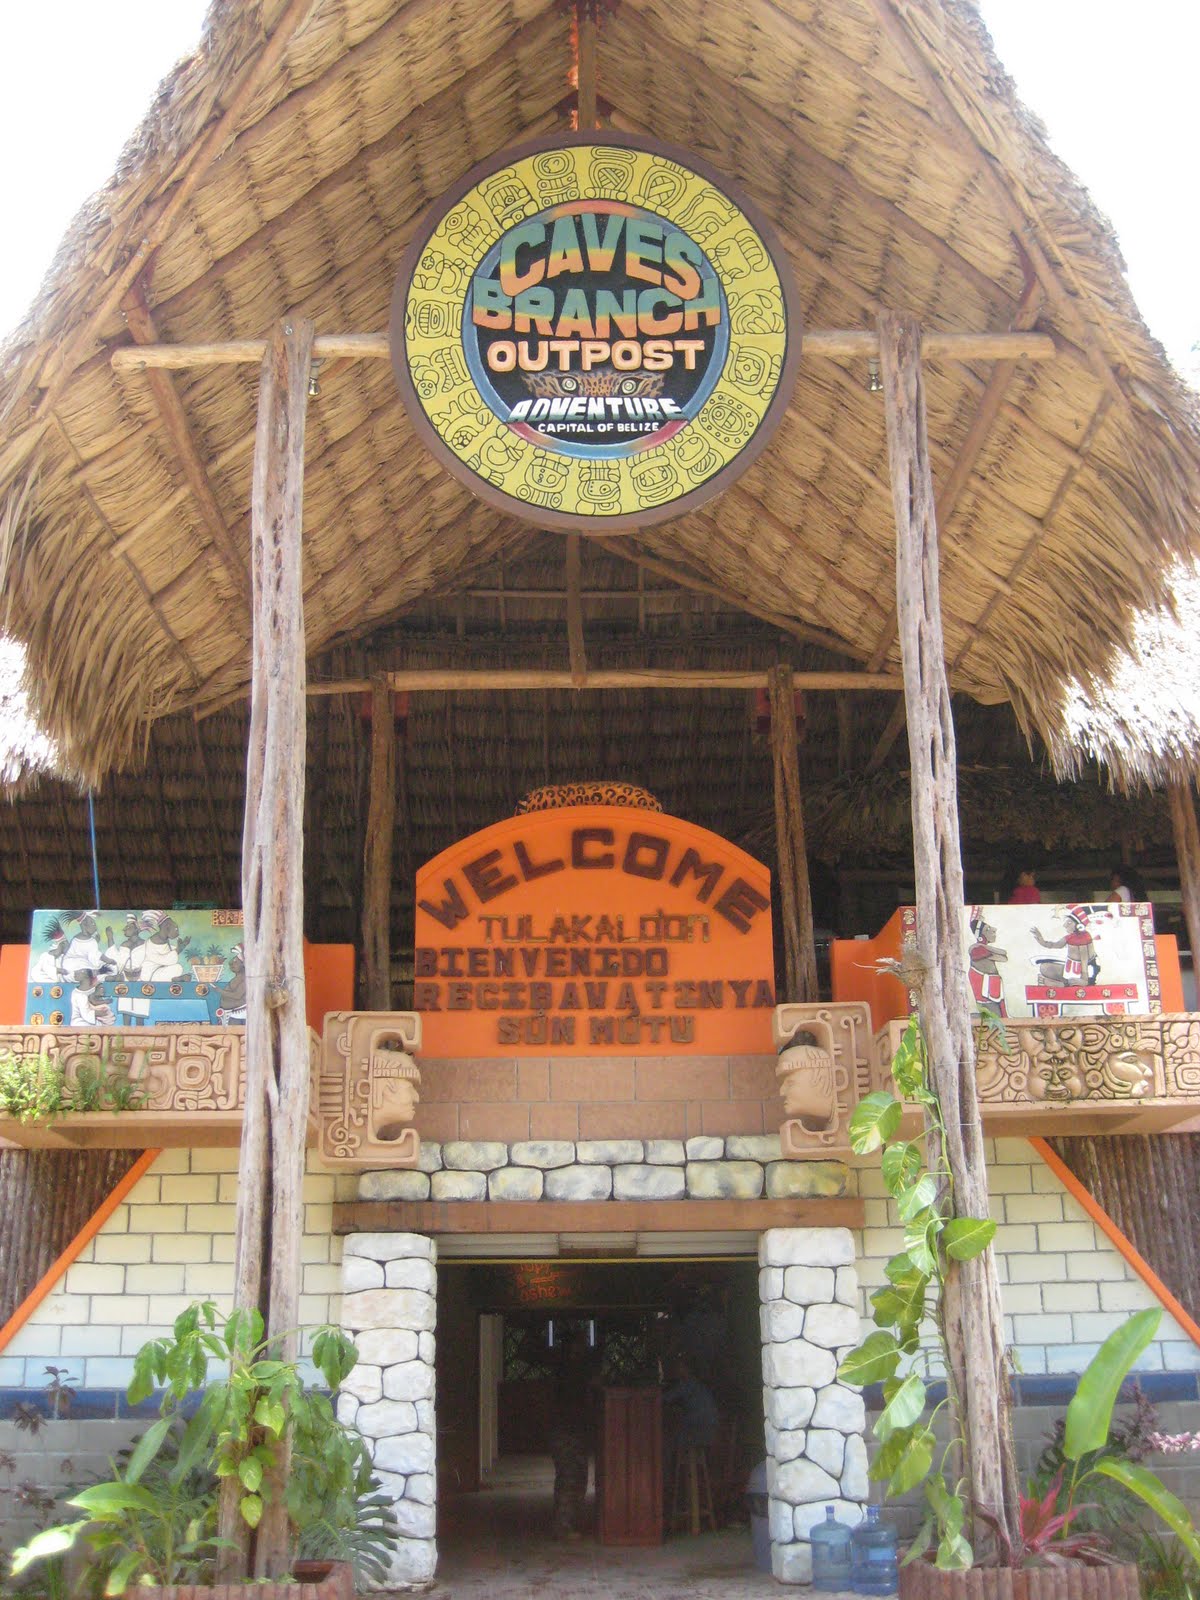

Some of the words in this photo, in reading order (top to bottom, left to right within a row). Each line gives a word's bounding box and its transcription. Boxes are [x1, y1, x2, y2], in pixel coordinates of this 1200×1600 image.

[500, 213, 702, 300] CAVES
[472, 277, 721, 339] BRANCH
[487, 339, 706, 373] OUTPOST
[507, 396, 689, 423] ADVENTURE
[537, 422, 594, 433] CAPITAL
[597, 422, 614, 433] OF
[617, 421, 660, 433] BELIZE
[417, 827, 772, 936] WELCOME
[414, 947, 669, 978] BIENVENIDO
